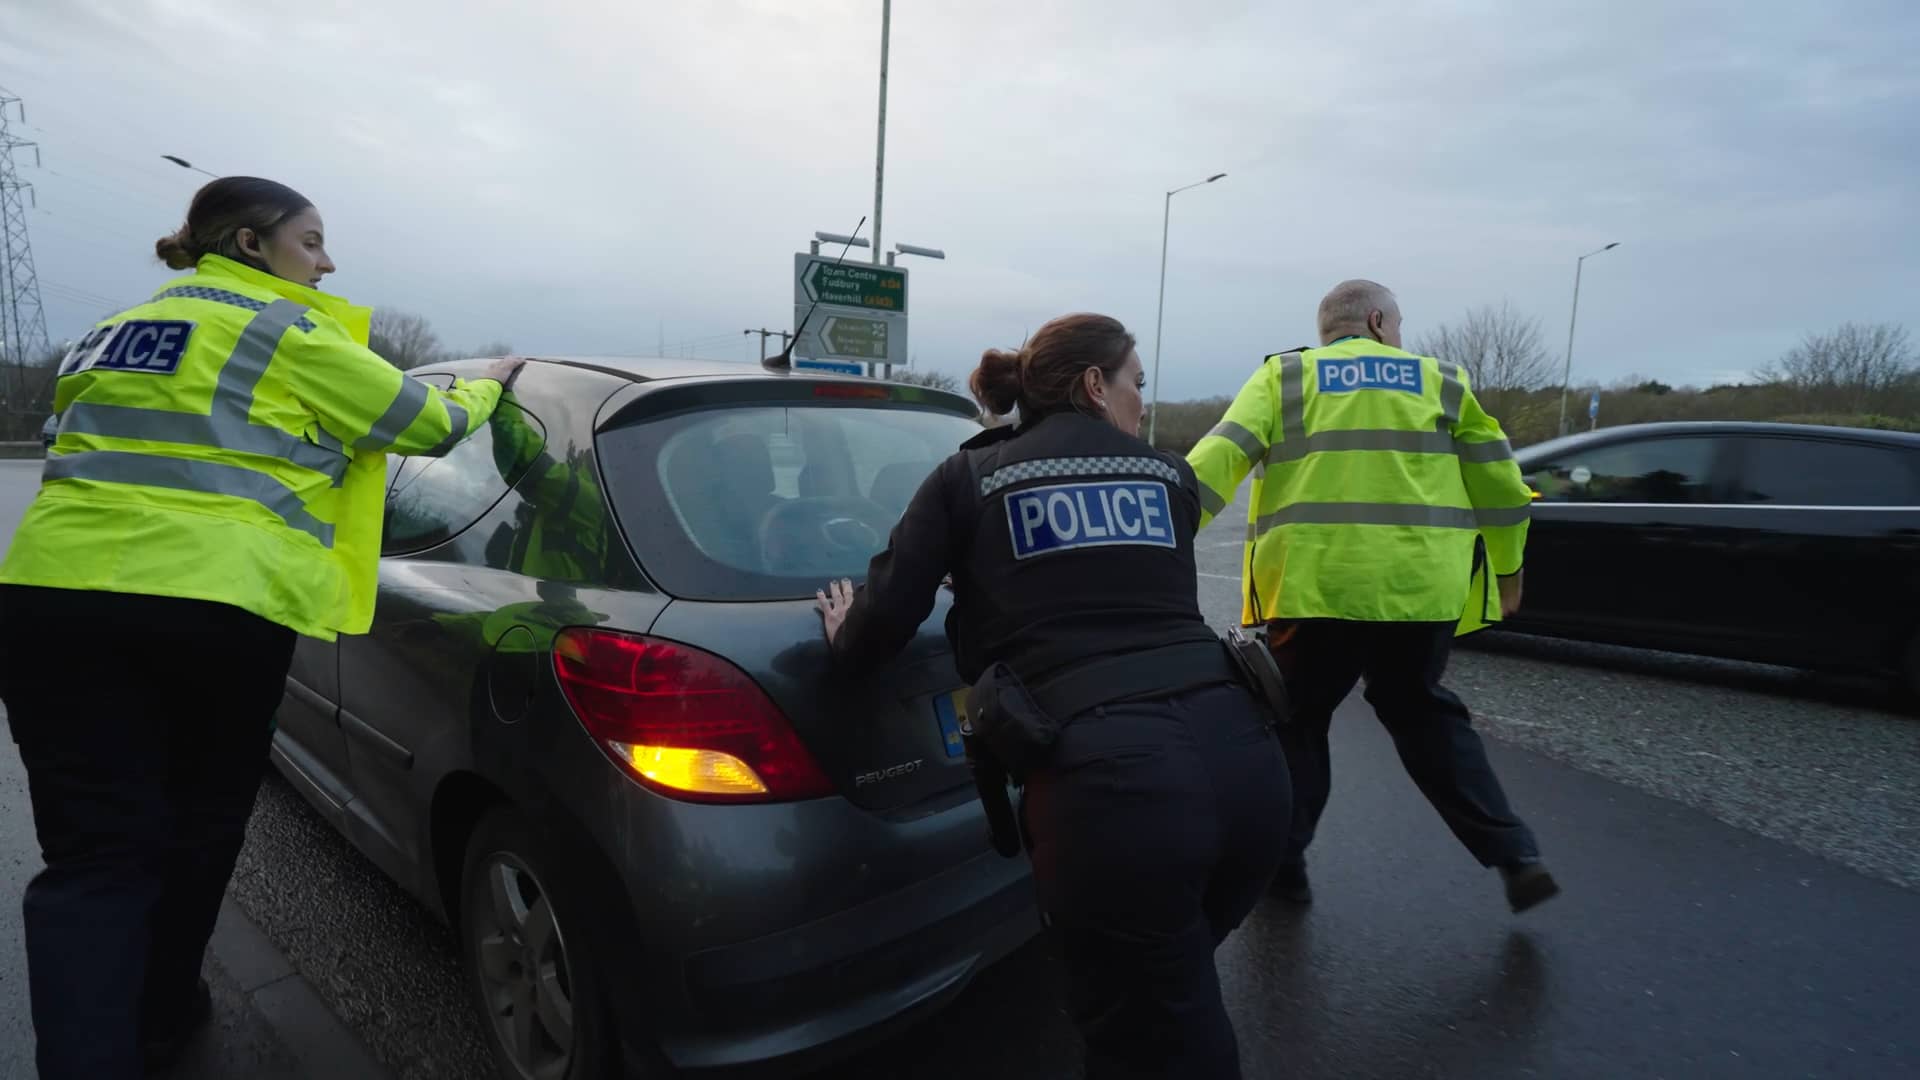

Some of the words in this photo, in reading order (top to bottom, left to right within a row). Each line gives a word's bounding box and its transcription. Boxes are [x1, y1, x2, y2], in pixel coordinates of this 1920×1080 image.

[822, 265, 846, 277] Town
[848, 269, 878, 281] Centre
[64, 325, 181, 368] LICE
[1324, 362, 1416, 387] POLICE
[1019, 488, 1166, 547] POLICE
[855, 759, 924, 788] PEUGEOT
